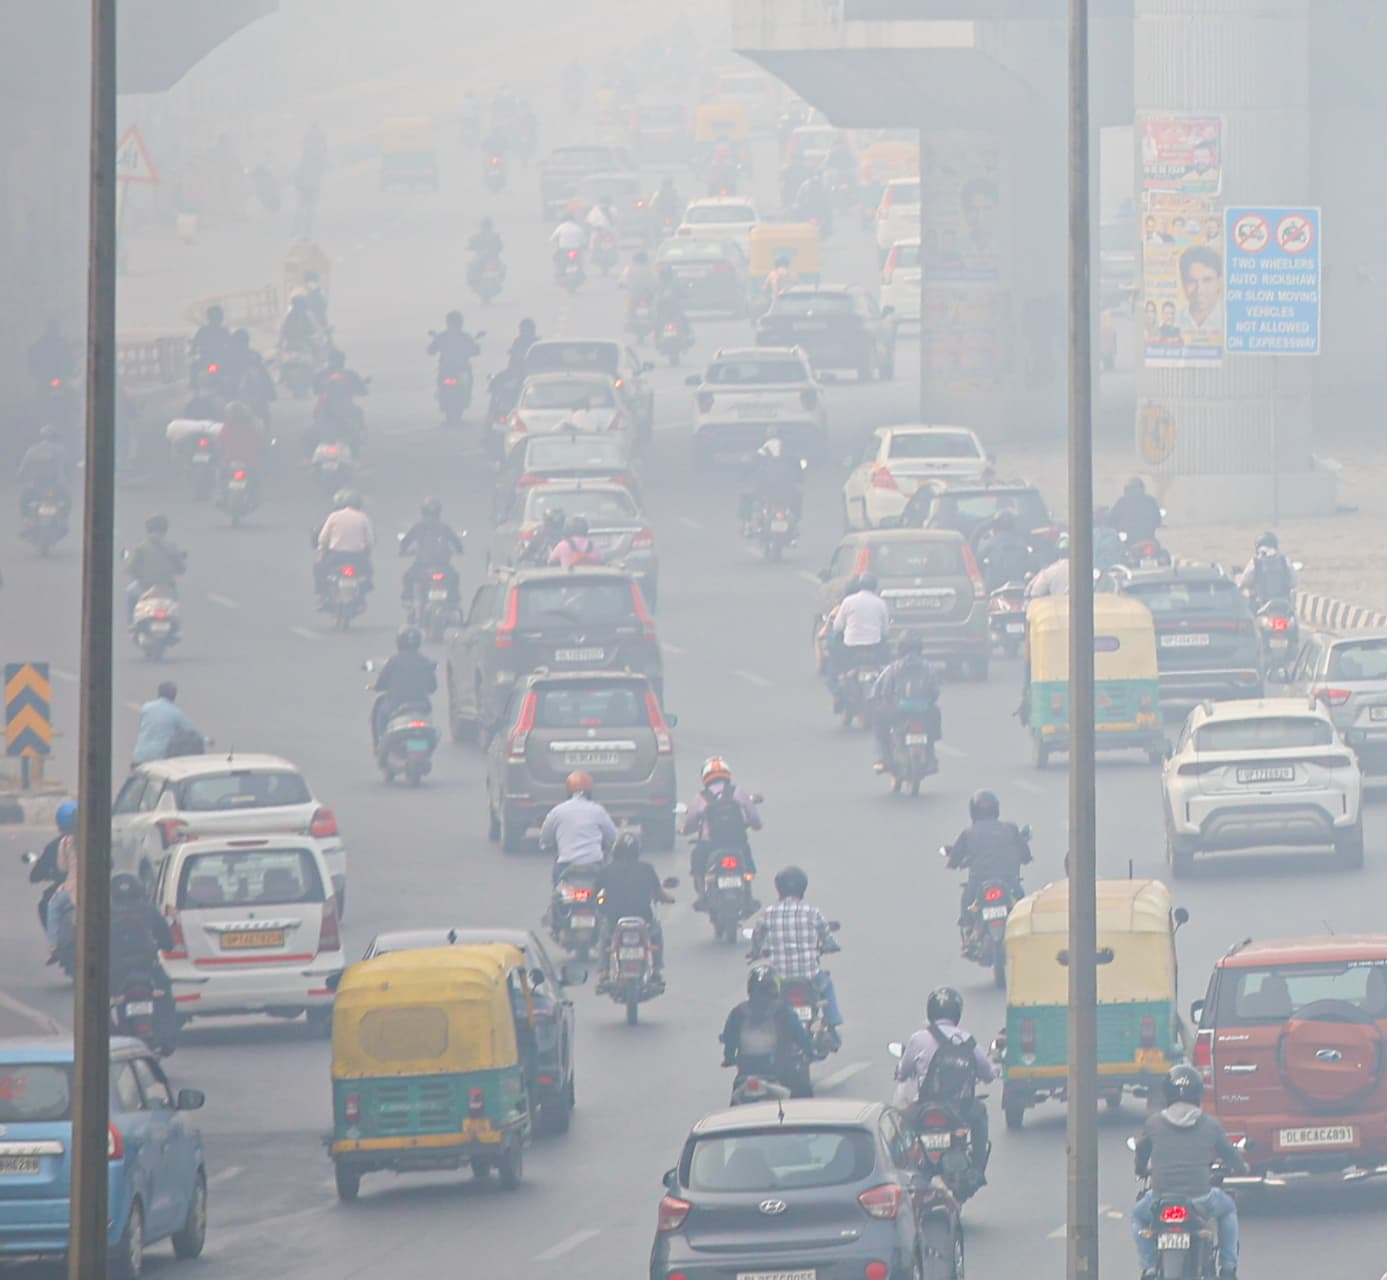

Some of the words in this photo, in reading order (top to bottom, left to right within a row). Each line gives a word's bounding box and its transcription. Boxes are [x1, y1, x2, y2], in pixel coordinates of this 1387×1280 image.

[1231, 257, 1256, 269] TWO
[1261, 257, 1315, 269] WHEELERS
[1229, 273, 1257, 285] AUTO
[1262, 272, 1316, 285] RICKSHAW
[1228, 290, 1241, 301] OR
[1244, 289, 1275, 302] SLOW
[1277, 289, 1318, 303] MOVING
[1246, 306, 1295, 318] VEHICLES
[1236, 321, 1256, 332] NOT
[1259, 321, 1310, 333] ALLOWED
[1228, 337, 1243, 349] ON
[1250, 336, 1316, 349] EXPRESSWAY
